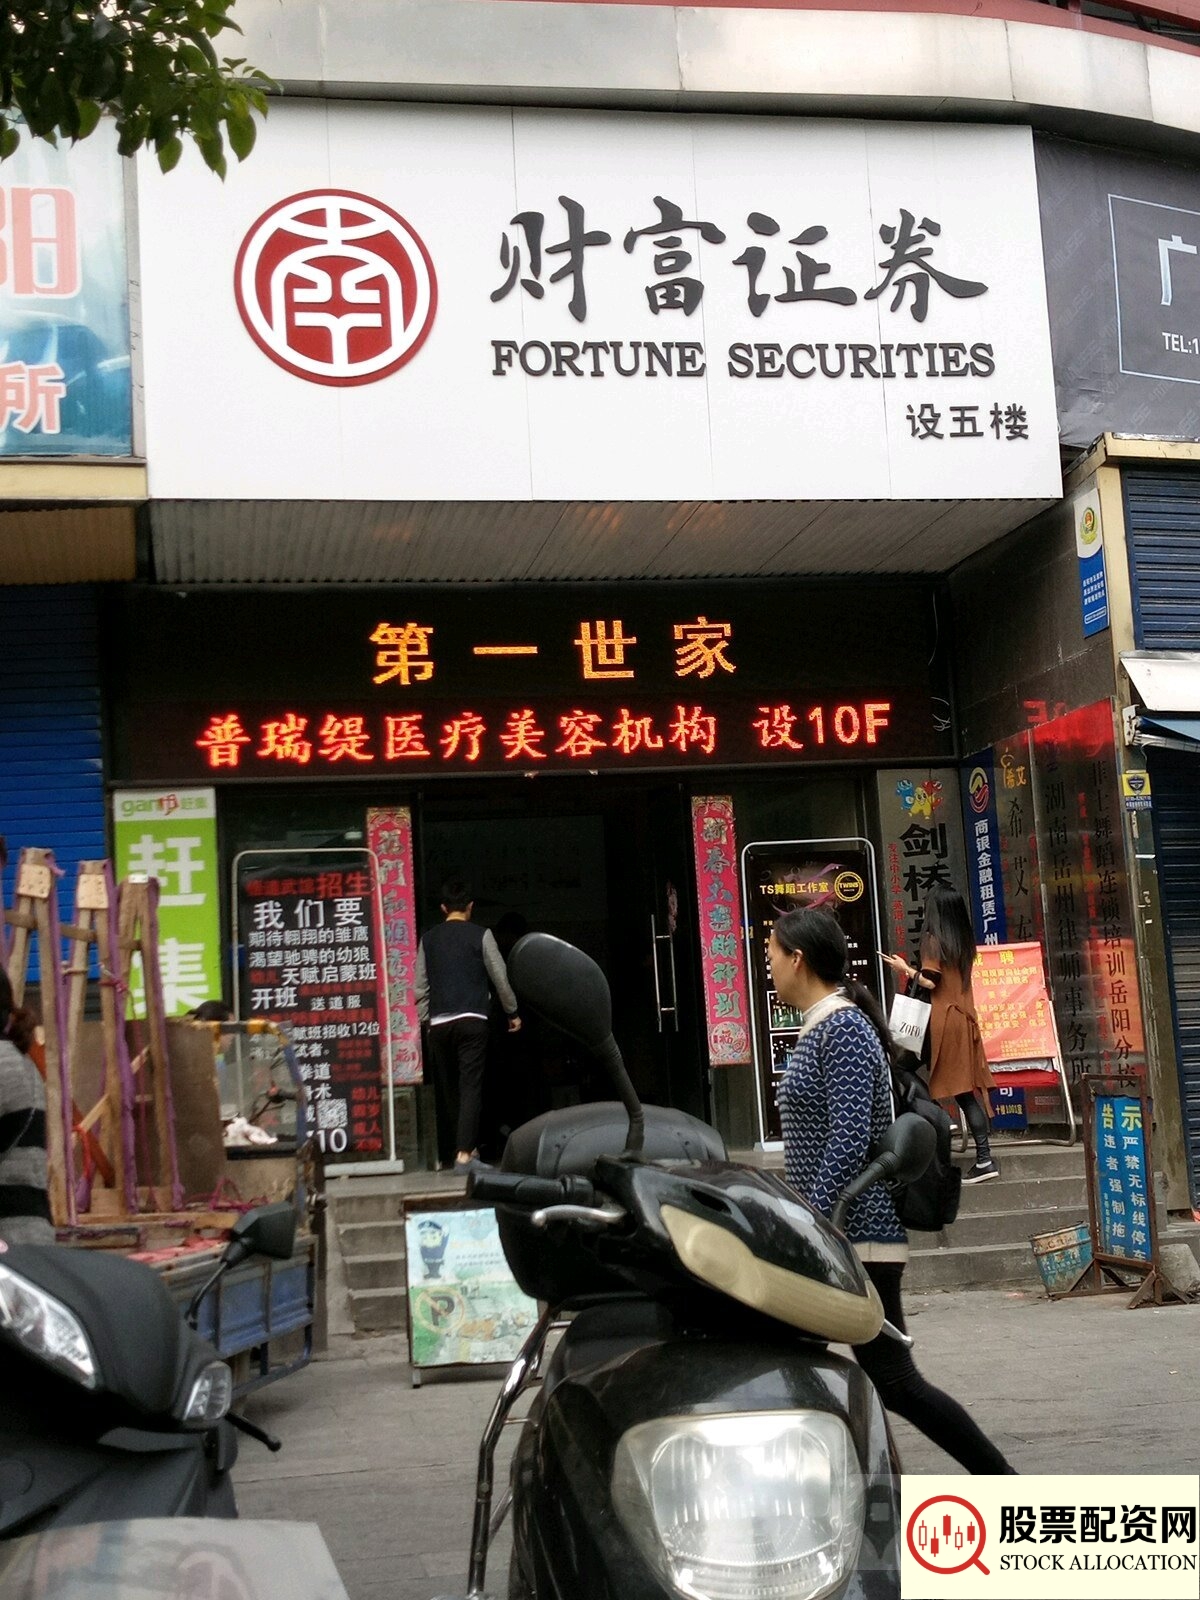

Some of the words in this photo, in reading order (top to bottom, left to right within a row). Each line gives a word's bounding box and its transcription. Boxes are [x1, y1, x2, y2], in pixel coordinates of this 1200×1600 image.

[491, 195, 988, 322] 财富证券
[491, 340, 706, 377] FORTUNE
[728, 342, 996, 379] SECURITIES
[907, 402, 1030, 440] 设五楼
[369, 617, 737, 686] 第一世家
[754, 701, 892, 753] 设10F
[252, 897, 365, 930] 我们要
[250, 986, 299, 1011] 开班
